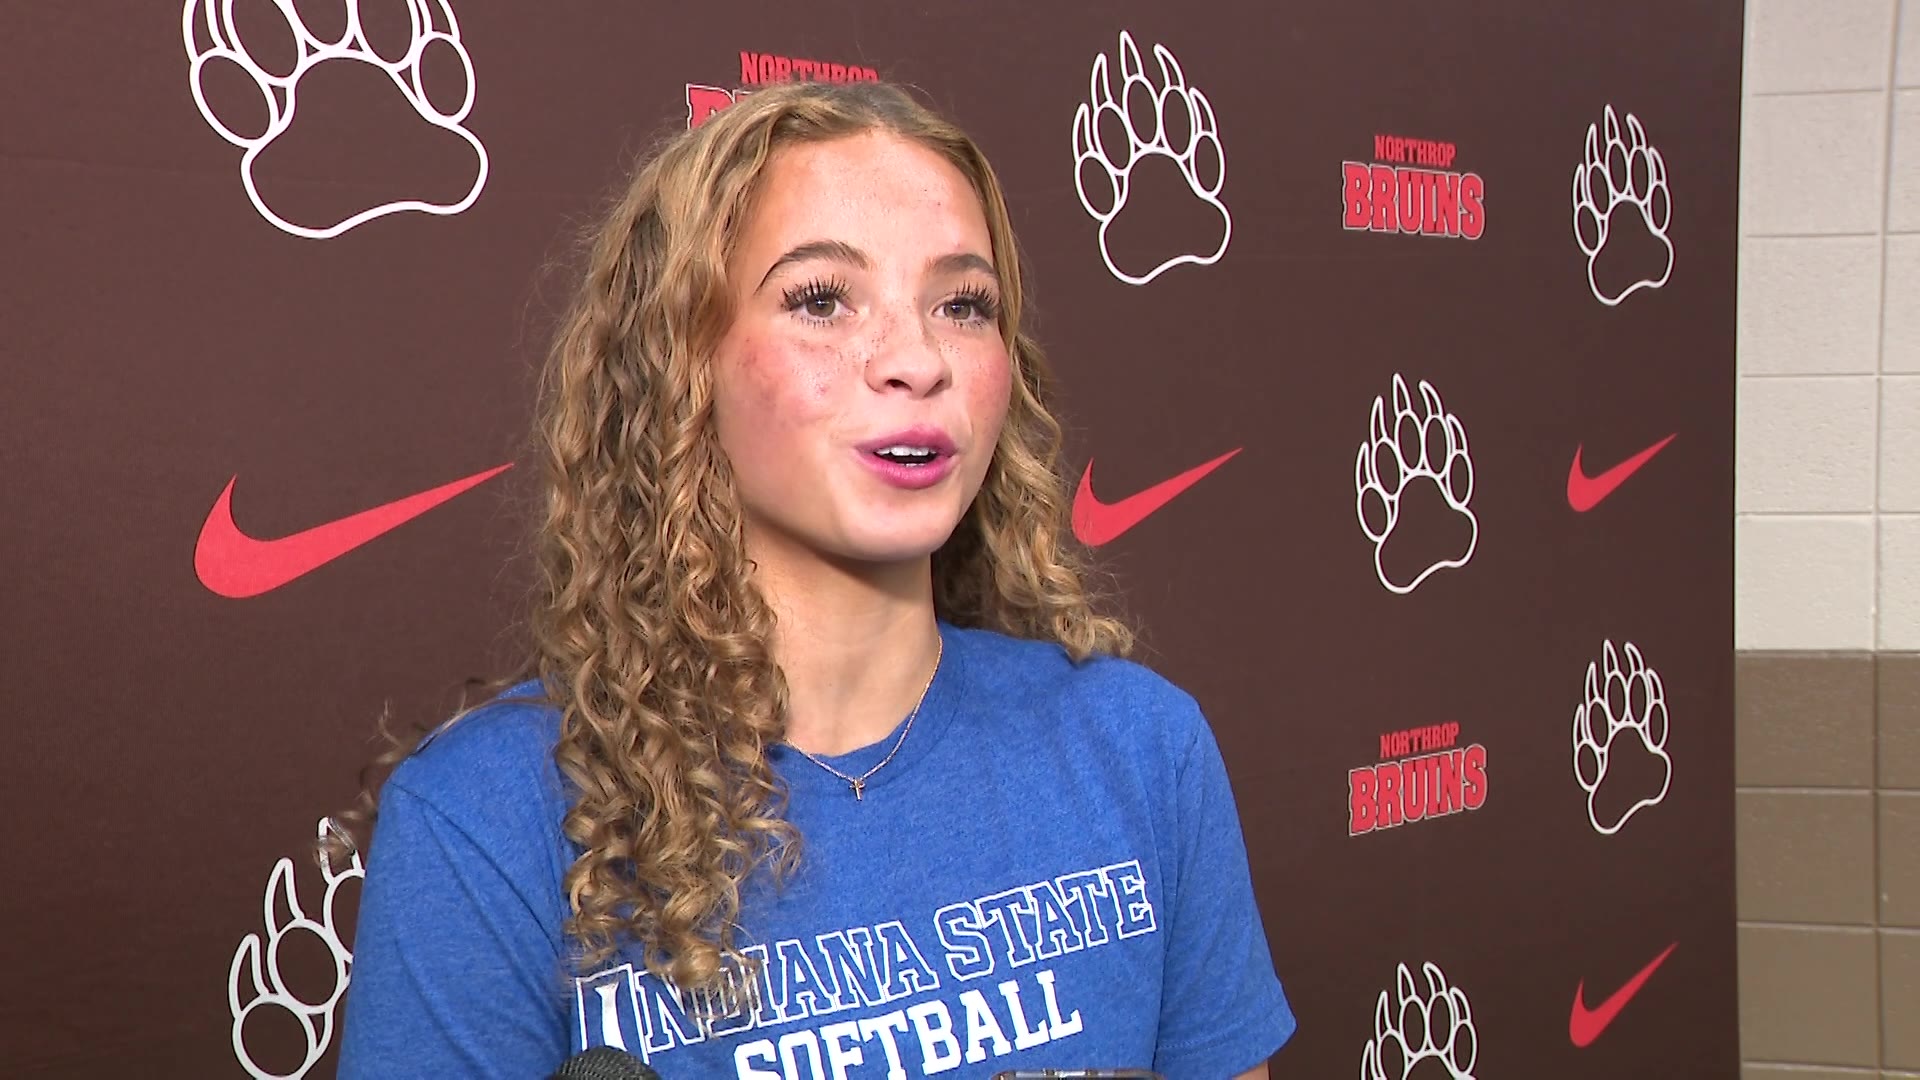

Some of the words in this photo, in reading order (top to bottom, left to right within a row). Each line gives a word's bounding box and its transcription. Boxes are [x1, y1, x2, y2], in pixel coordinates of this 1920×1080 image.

[1374, 134, 1456, 168] NORTHROP
[1342, 160, 1486, 240] BRUINS
[1380, 721, 1460, 758] NORTHROP
[1348, 743, 1488, 836] BRUINS
[576, 921, 940, 1066] INDIANA
[933, 859, 1158, 979] STATE
[733, 969, 1084, 1080] SOFTBALL
